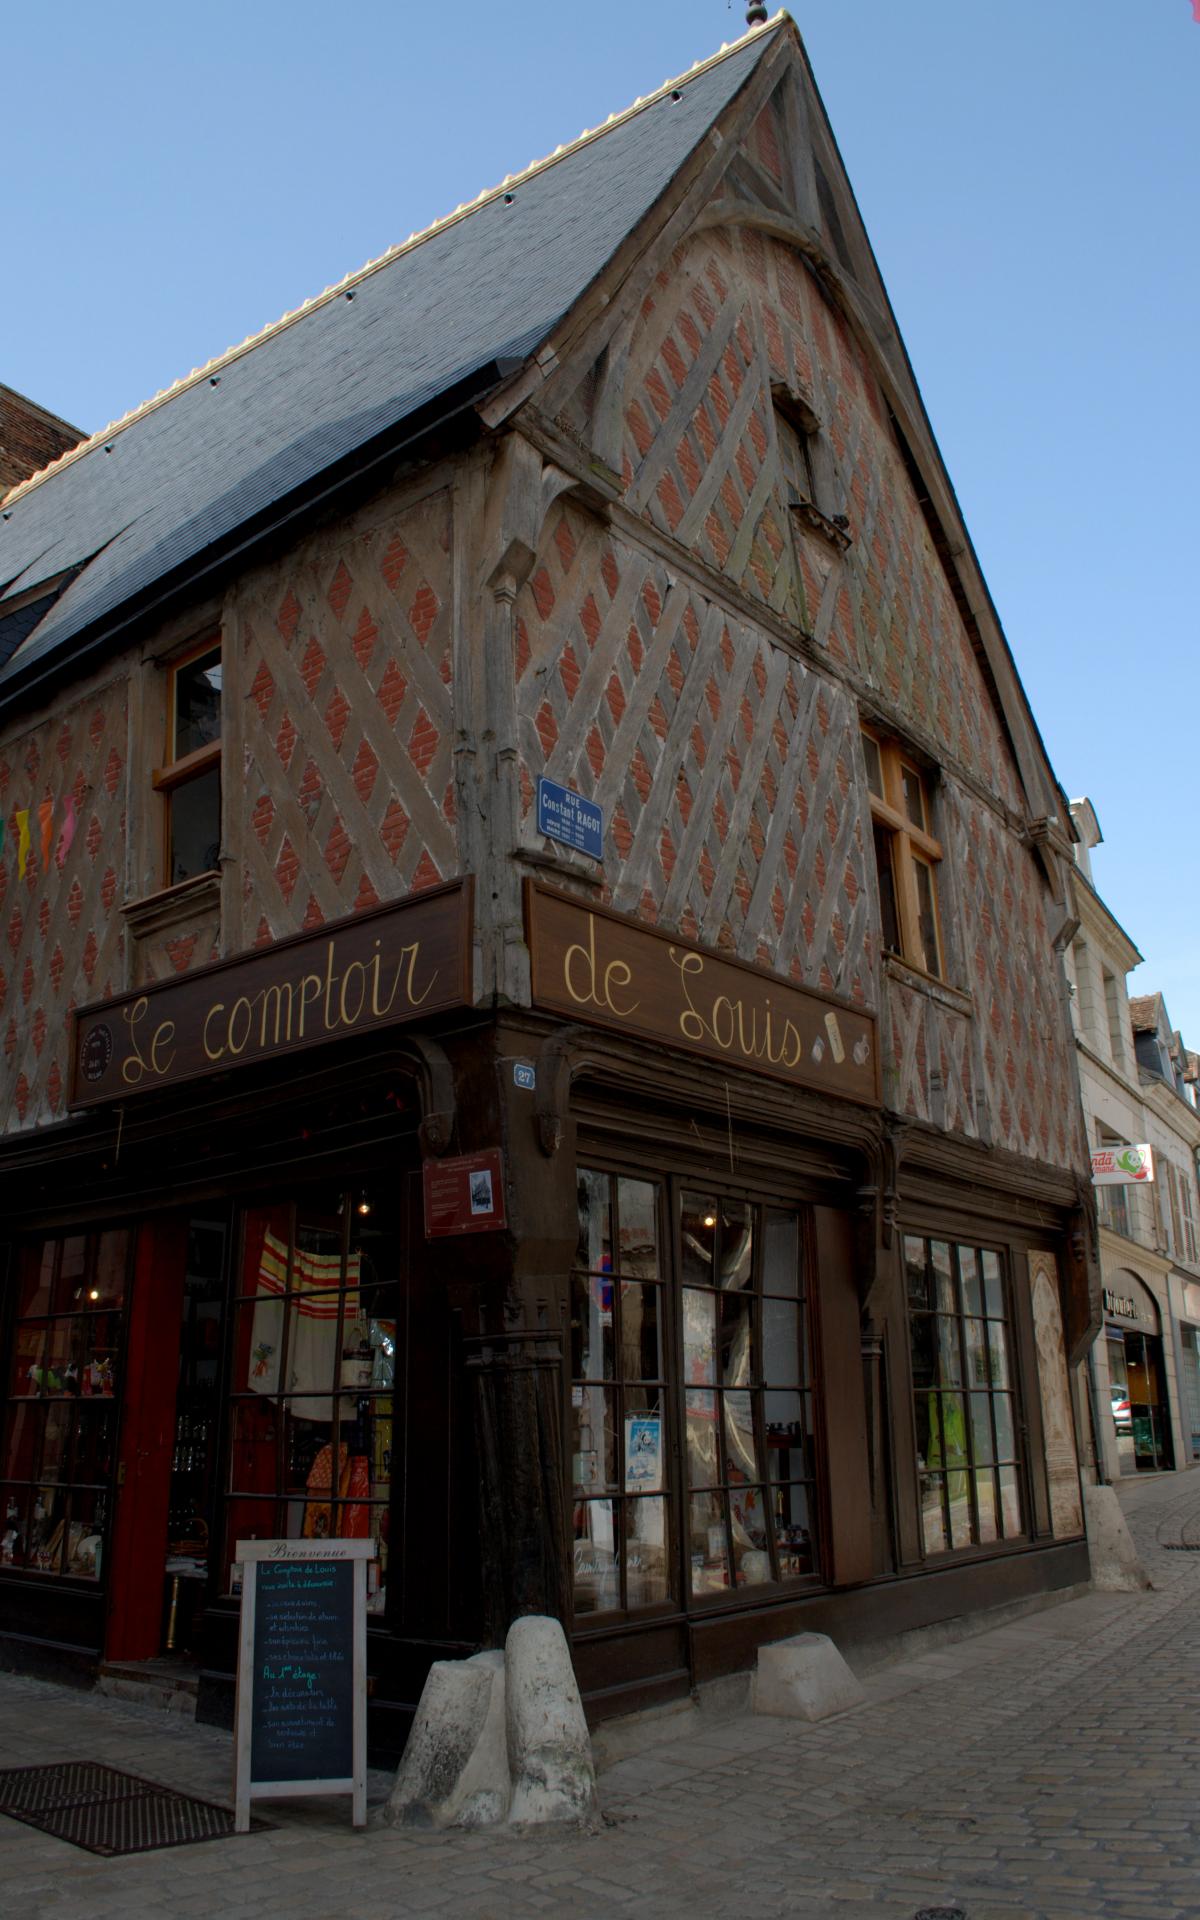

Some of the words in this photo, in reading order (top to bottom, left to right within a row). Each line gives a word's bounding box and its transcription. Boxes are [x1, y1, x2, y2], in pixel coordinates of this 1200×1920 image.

[565, 794, 580, 808] RUE
[543, 794, 575, 821] Constant
[577, 810, 601, 834] RAGOT
[565, 912, 641, 1017] de
[669, 946, 801, 1067] Louis
[122, 996, 176, 1083] Le
[203, 939, 438, 1061] comptoir
[518, 1070, 530, 1084] 27
[268, 1542, 347, 1558] Bienvenue
[315, 1563, 337, 1574] Louis
